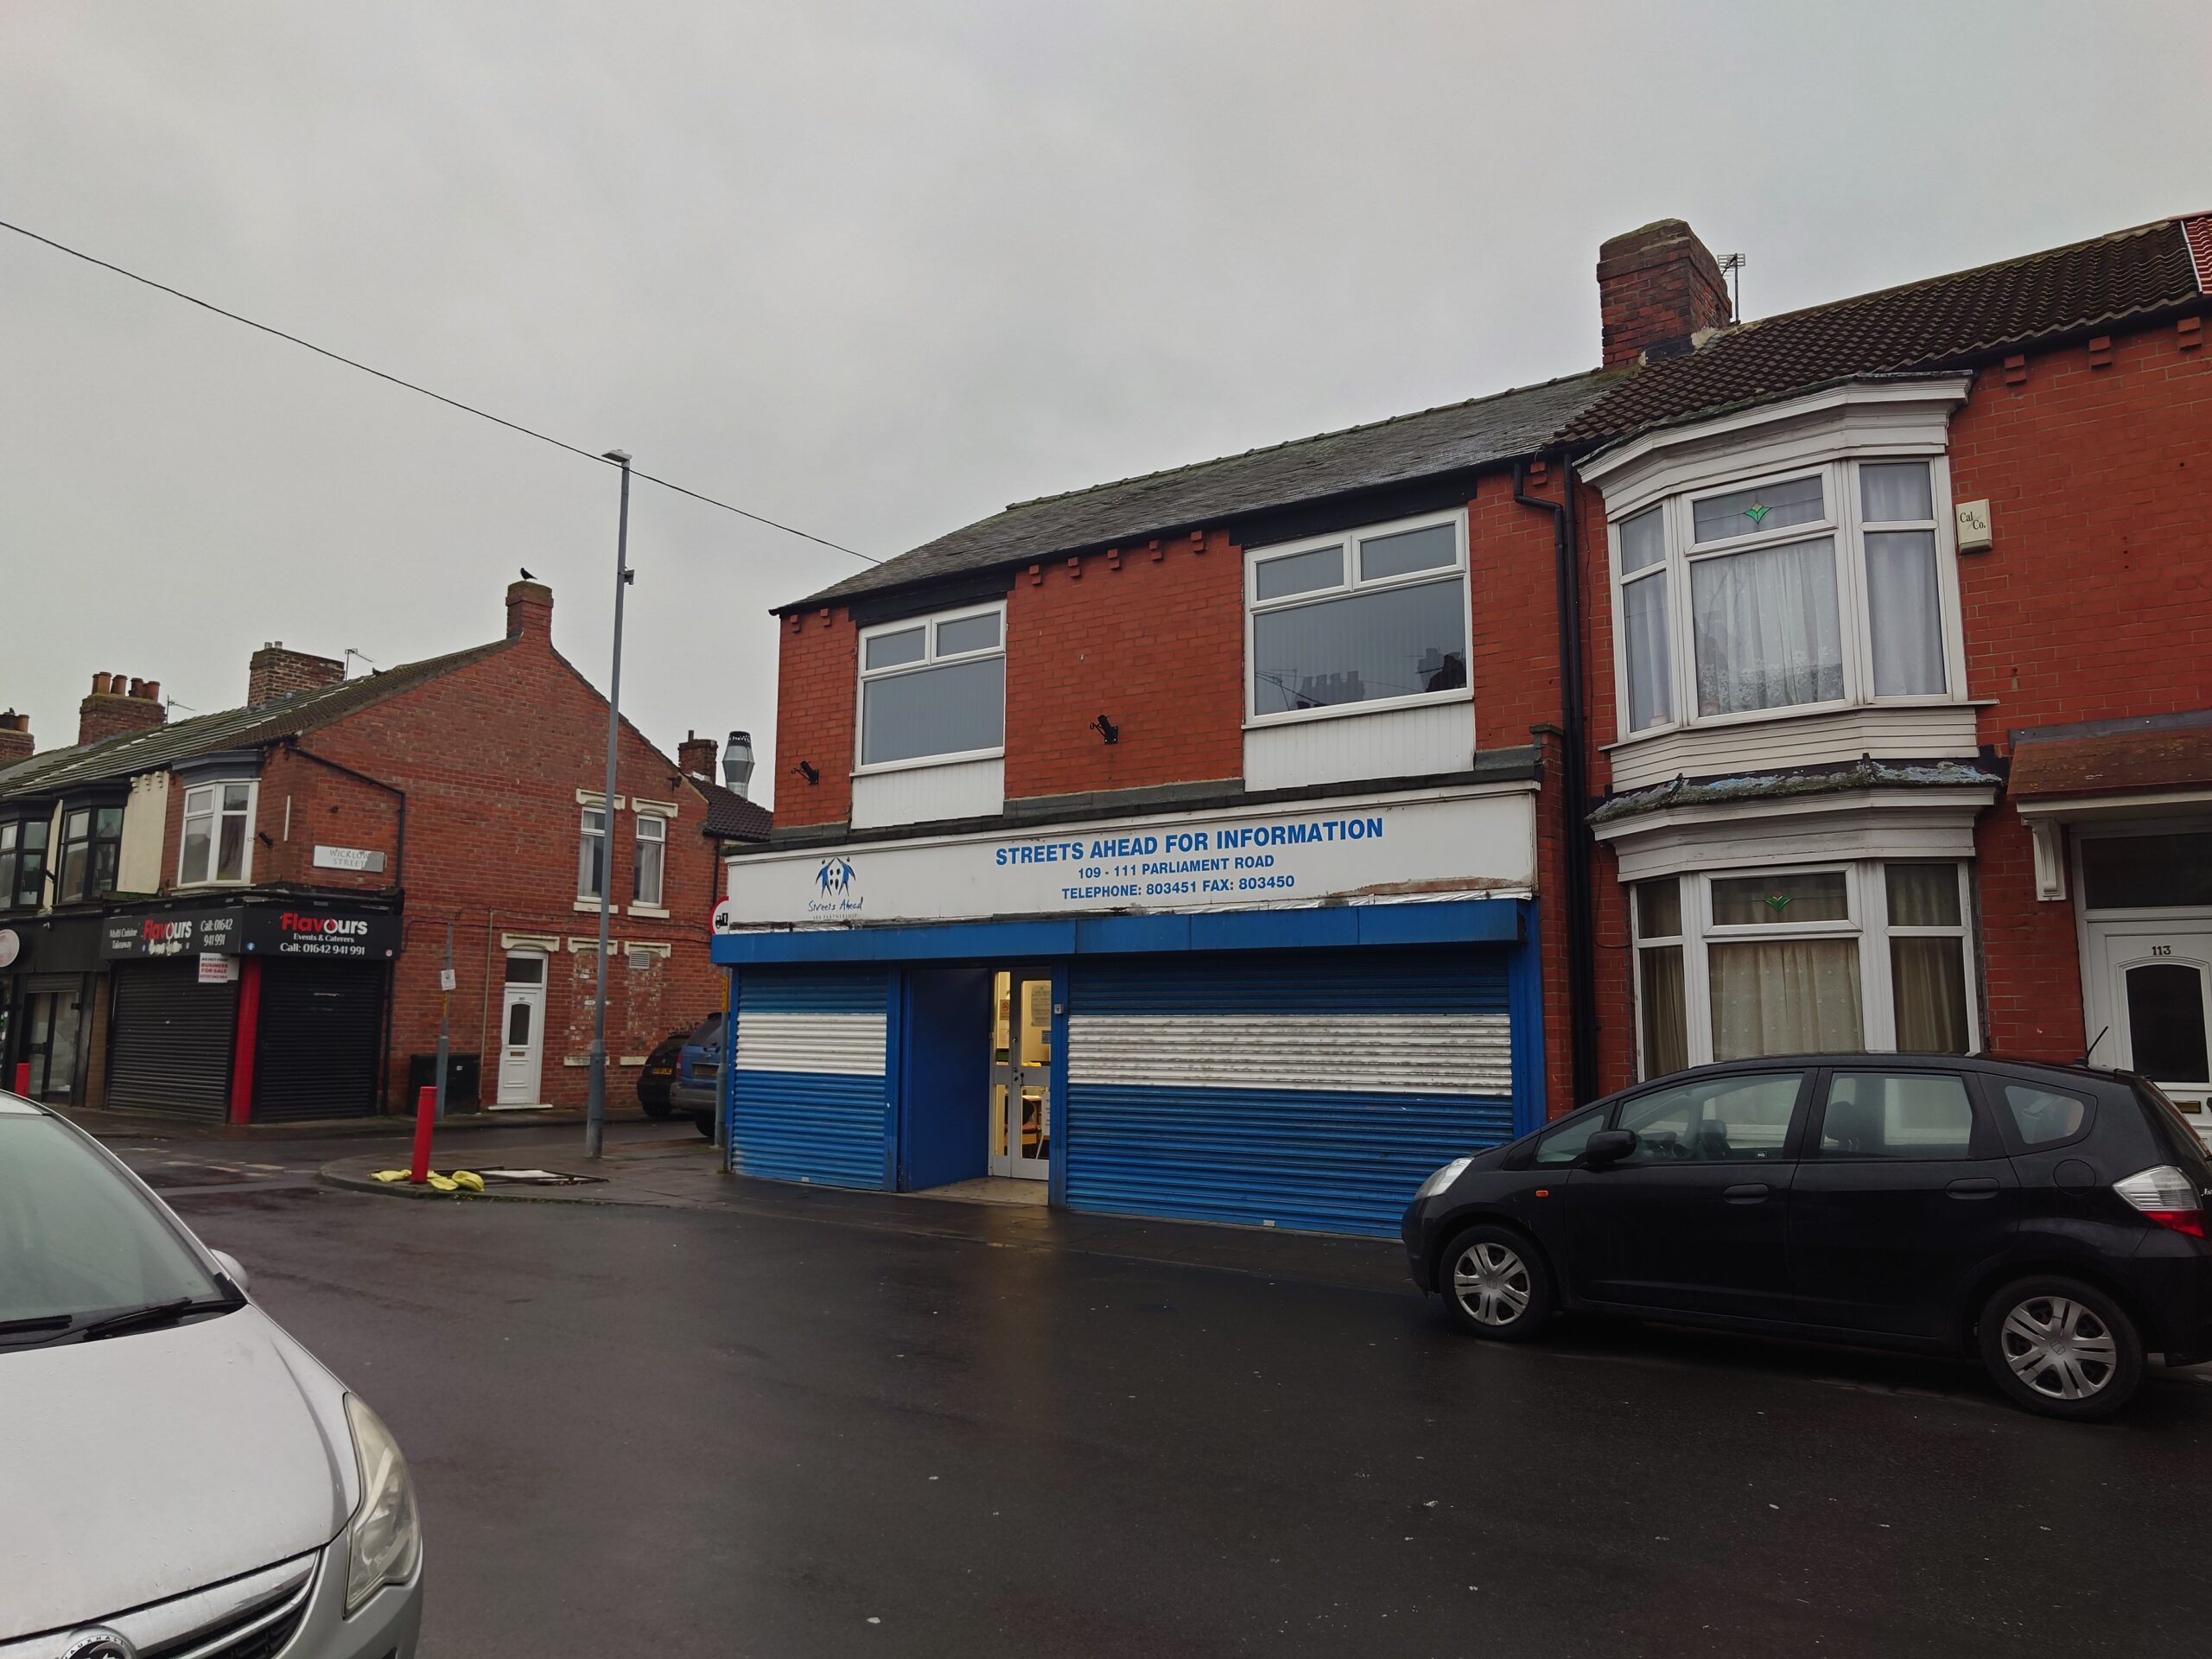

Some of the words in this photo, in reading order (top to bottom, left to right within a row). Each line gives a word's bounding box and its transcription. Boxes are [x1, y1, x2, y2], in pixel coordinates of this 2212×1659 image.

[1960, 512, 1974, 523] Cal
[1973, 520, 1986, 530] Co.
[995, 842, 1084, 865] STREETS
[1090, 836, 1158, 858] AHEAD
[1166, 832, 1208, 853] FOR
[1217, 817, 1382, 849] INFORMATION
[333, 857, 365, 868] STREET
[1078, 867, 1101, 879] 109
[1114, 865, 1136, 877] 111
[1142, 858, 1230, 875] PARLIAMENT
[1235, 855, 1274, 869] ROAD
[1062, 884, 1141, 899] TELEPHONE:
[1146, 881, 1196, 895] 803451
[1202, 879, 1234, 893] FAX:
[1238, 875, 1295, 890] 803450
[807, 899, 836, 912] Streets
[839, 896, 864, 911] Ahead
[143, 919, 193, 941] Flavours
[213, 918, 233, 931] 01642
[281, 912, 368, 935] Flavours
[203, 934, 213, 946] 941
[214, 934, 226, 946] 991
[294, 933, 317, 942] Events
[325, 934, 355, 943] Caterers
[280, 943, 302, 952] Call:
[302, 944, 331, 954] 01642
[333, 945, 348, 955] 941
[350, 945, 365, 956] 991
[2152, 945, 2171, 956] 113
